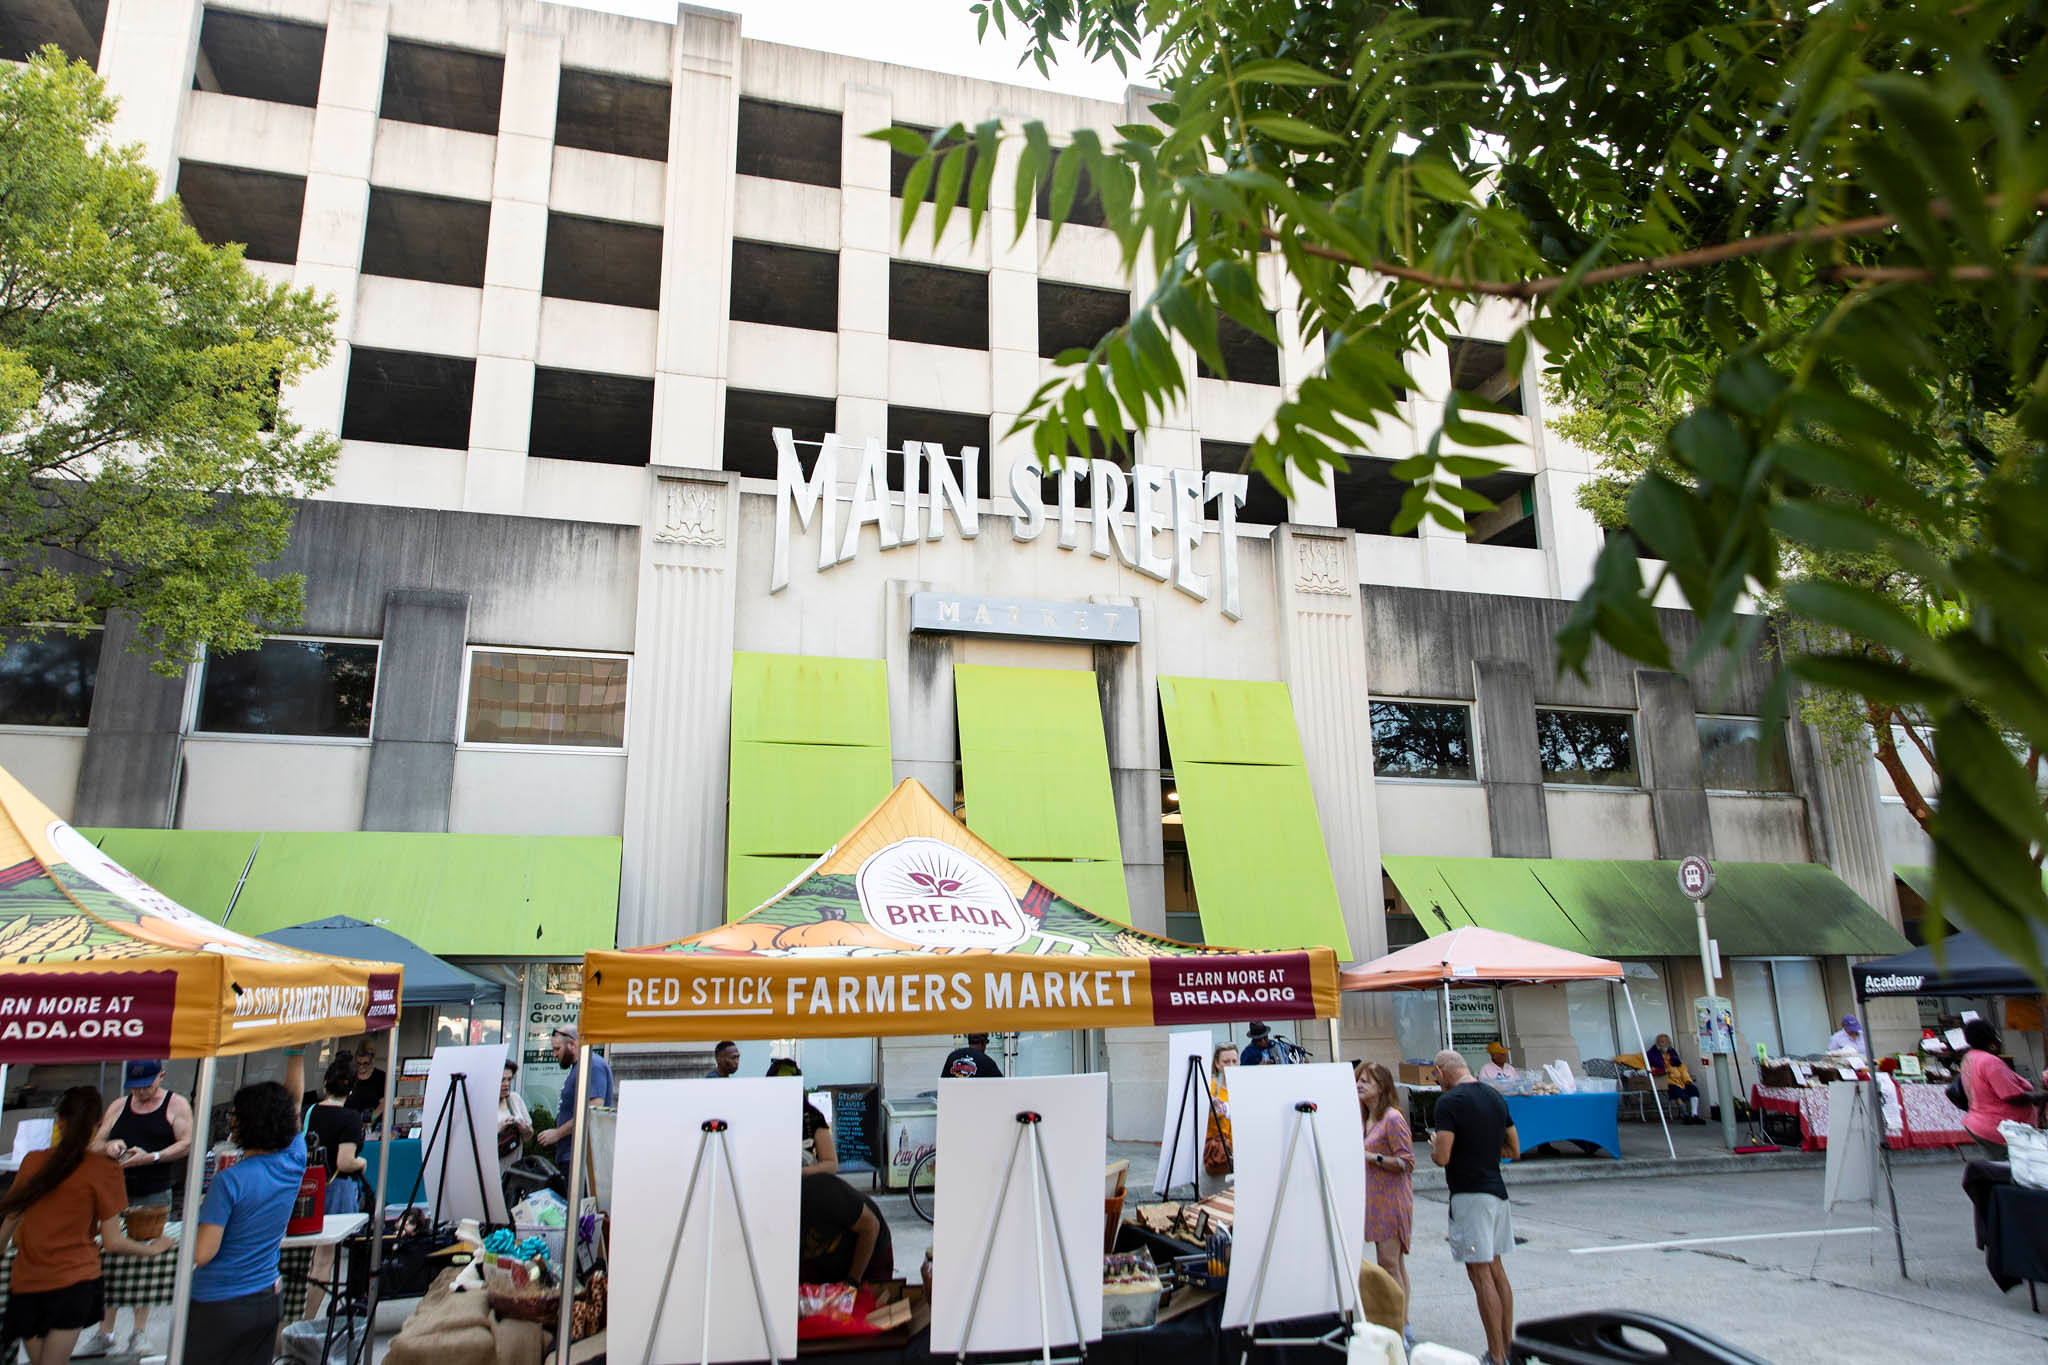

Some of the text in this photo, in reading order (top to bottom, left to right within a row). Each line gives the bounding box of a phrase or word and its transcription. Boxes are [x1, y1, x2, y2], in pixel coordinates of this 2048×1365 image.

[770, 427, 1249, 622] MAIN STREET
[937, 600, 1121, 633] MARKET
[886, 904, 1013, 930] BREADA
[1178, 969, 1285, 987] LEARN MORE AT
[1865, 974, 1923, 990] Academy
[626, 970, 1136, 1015] RED STICK FARMERS MARKET
[1170, 987, 1295, 1006] BREADA.ORG
[36, 996, 102, 1015] MORE
[105, 996, 135, 1014] AT
[254, 987, 281, 1016] STICK
[279, 984, 330, 1025] FARMERS
[329, 985, 367, 1018] MARKET
[534, 1002, 562, 1010] Good
[1917, 999, 1938, 1008] wing
[530, 1011, 577, 1024] Grow
